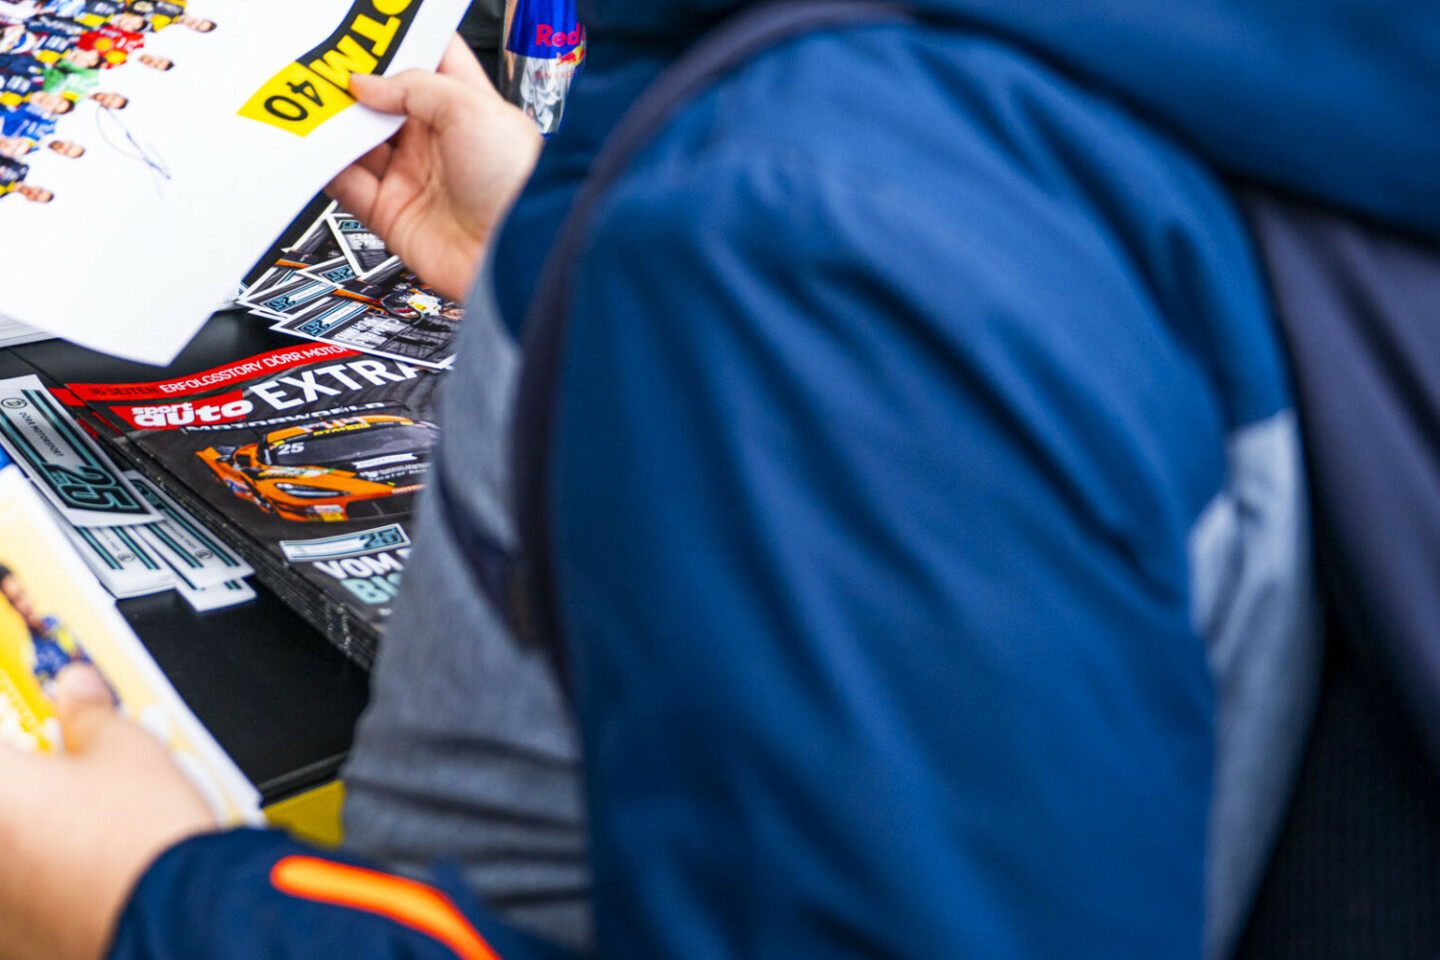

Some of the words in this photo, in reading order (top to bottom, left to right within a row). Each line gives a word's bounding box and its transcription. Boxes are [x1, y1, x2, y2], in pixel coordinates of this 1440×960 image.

[535, 22, 582, 48] Red
[263, 79, 325, 122] 40
[159, 361, 263, 393] ERFOLGSSTORY
[262, 351, 304, 368] DÖRR
[131, 401, 193, 416] sport
[133, 399, 254, 428] auto
[279, 442, 305, 456] 25
[43, 462, 148, 513] 25
[313, 551, 405, 580] VOM
